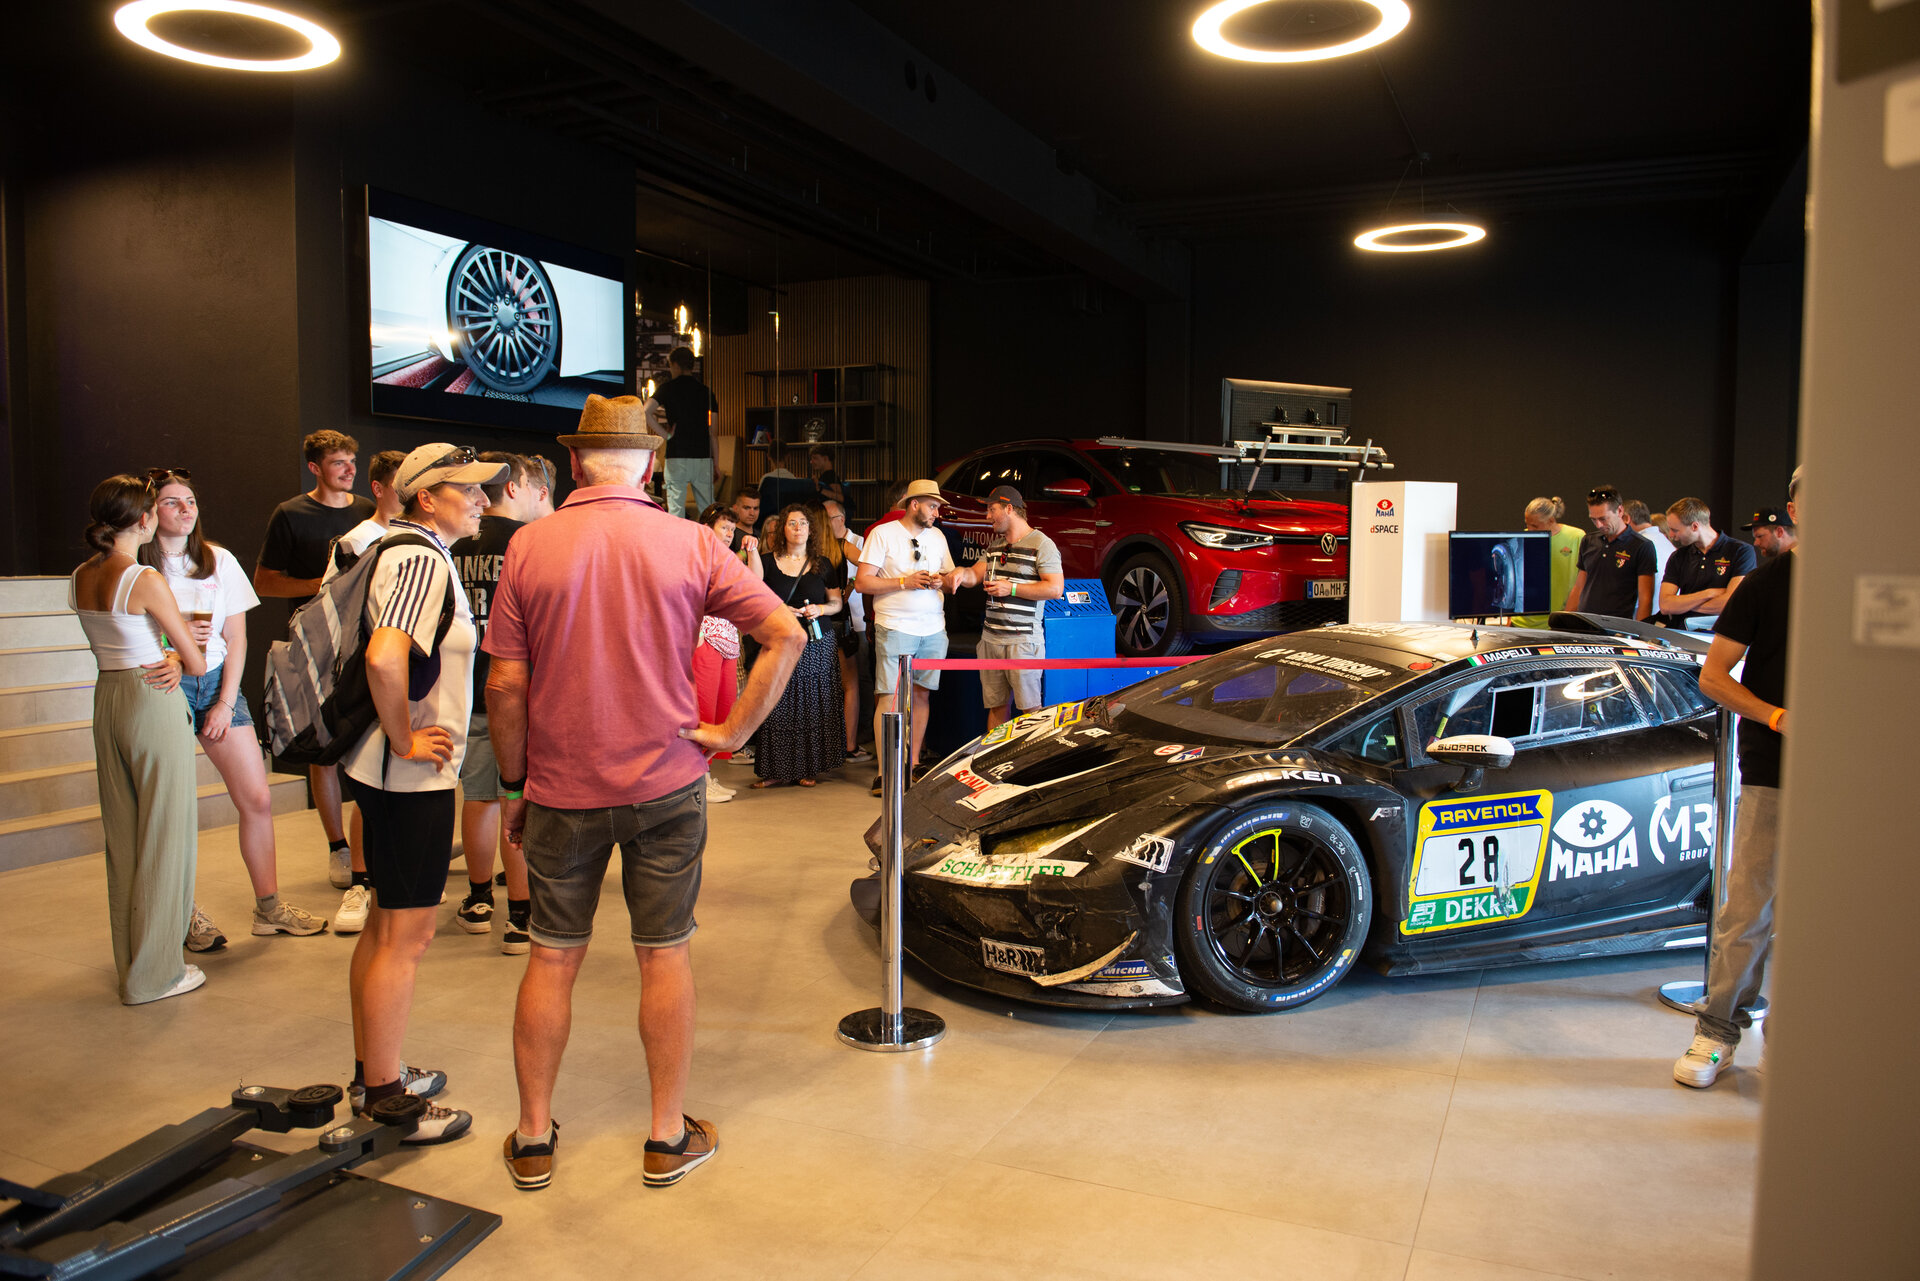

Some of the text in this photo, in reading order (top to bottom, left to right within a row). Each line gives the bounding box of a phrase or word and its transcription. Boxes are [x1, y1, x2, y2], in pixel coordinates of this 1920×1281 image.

[1375, 507, 1395, 517] MAHA
[1370, 525, 1399, 534] dSPACE
[1484, 648, 1531, 663] MAPELLI
[1553, 645, 1616, 655] ENGELHART
[1638, 649, 1692, 662] ENGSTLER
[1440, 803, 1534, 825] RAVENOL
[1458, 835, 1500, 886] 28
[1548, 826, 1639, 882] MAHA
[1679, 848, 1709, 862] GROUP
[984, 942, 1019, 967] H&R
